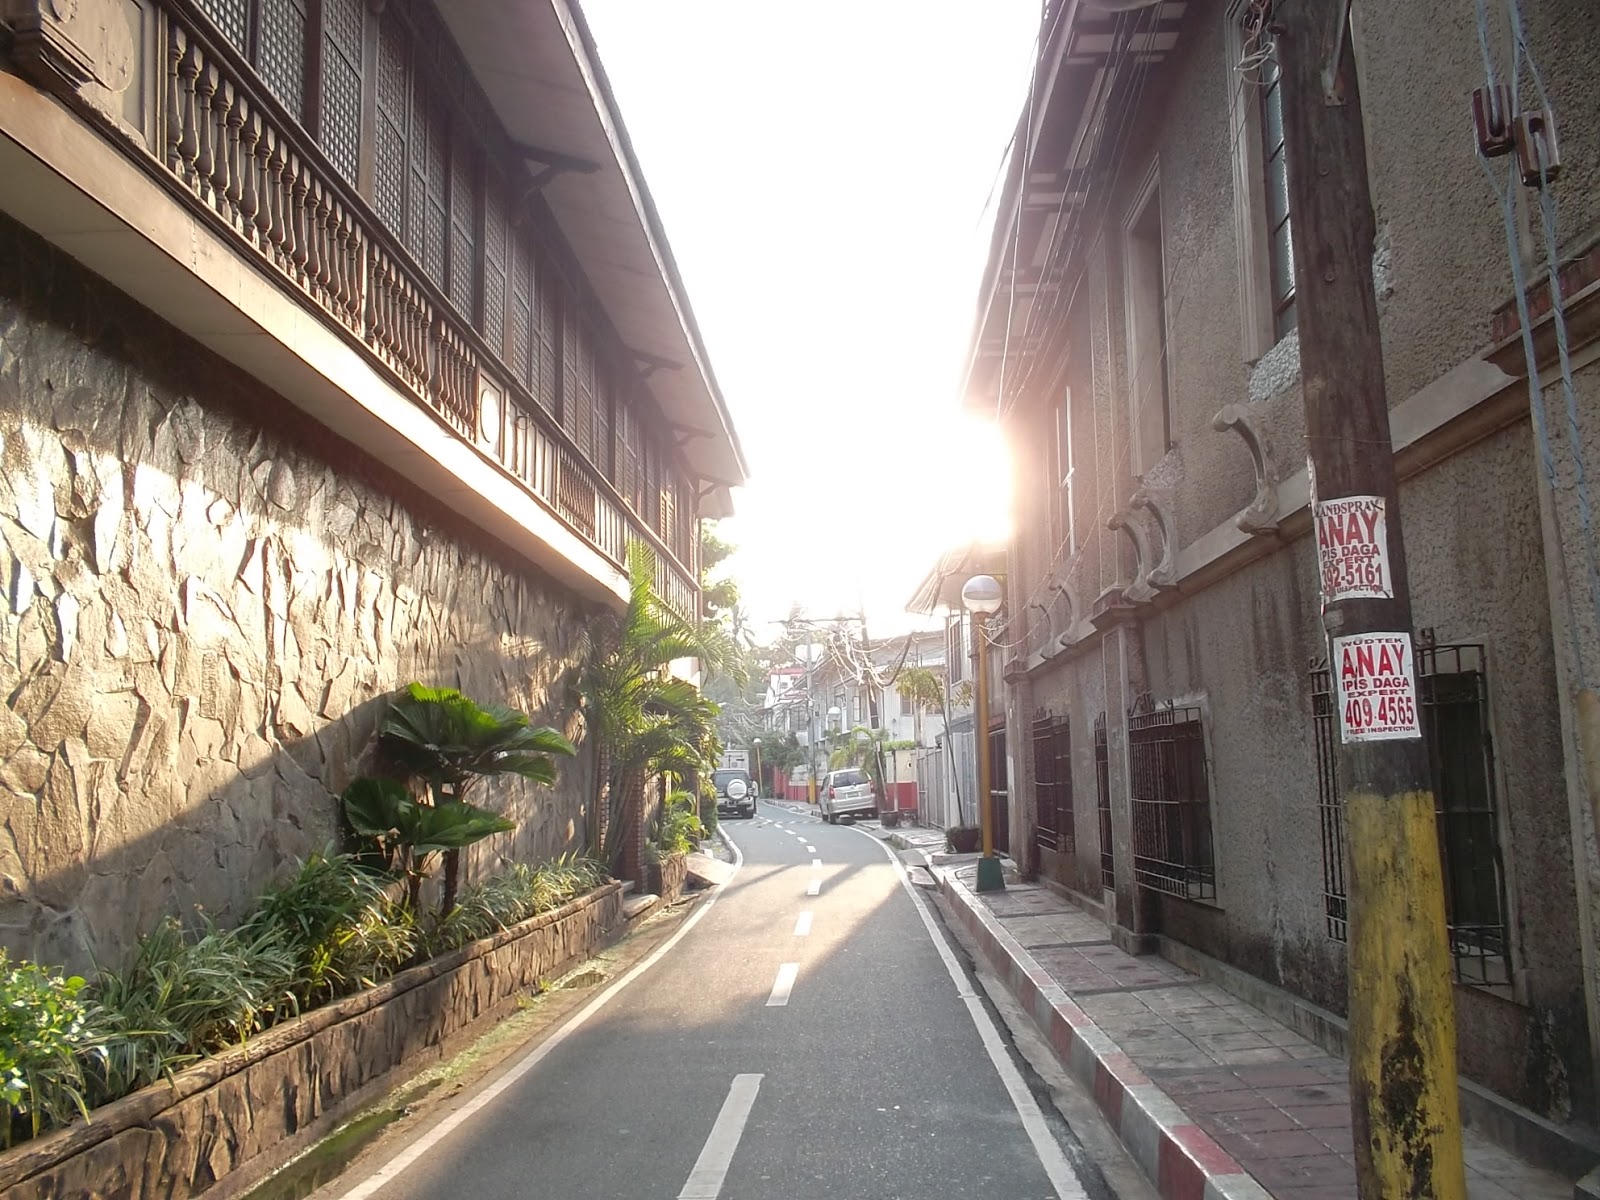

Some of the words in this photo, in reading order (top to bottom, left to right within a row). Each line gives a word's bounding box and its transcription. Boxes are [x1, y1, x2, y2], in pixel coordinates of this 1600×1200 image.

[1319, 511, 1378, 550] ANAY
[1341, 544, 1380, 556] DAGA
[1323, 555, 1375, 569] EXPERT
[1341, 637, 1403, 647] WUDTEK
[1342, 644, 1405, 680] ANAY
[1342, 679, 1368, 691] IPIS
[1373, 677, 1409, 689] DAGA
[1347, 689, 1407, 698] EXPERT
